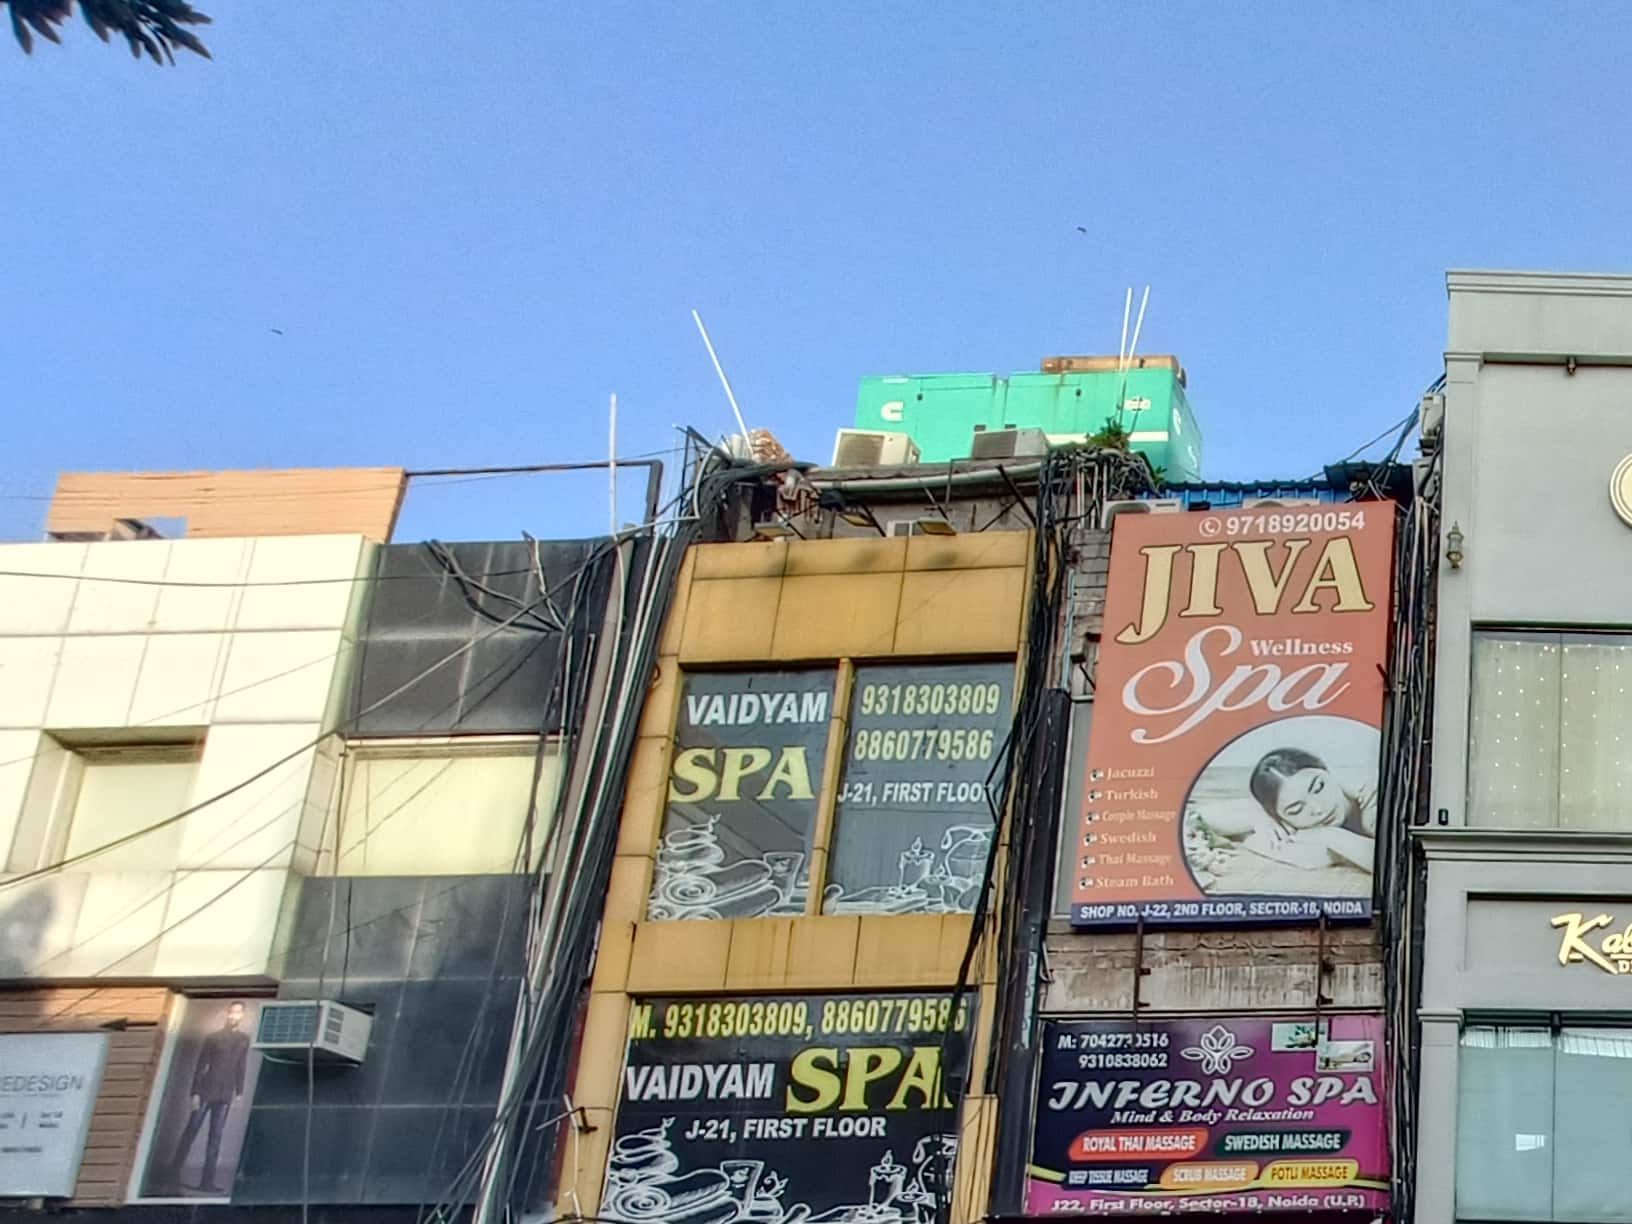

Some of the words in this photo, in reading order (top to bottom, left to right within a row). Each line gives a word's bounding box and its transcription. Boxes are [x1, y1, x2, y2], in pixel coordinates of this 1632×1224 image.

[1225, 511, 1366, 536] 9718920054
[1114, 535, 1376, 645] JIVA
[1249, 638, 1353, 656] Wellness
[1122, 625, 1351, 744] Spa
[687, 691, 827, 726] VAIDYAM
[861, 684, 1000, 716] 9318303809
[853, 729, 994, 760] 8860779586
[669, 746, 817, 803] SPA
[1106, 766, 1155, 781] Jacuzzi
[882, 782, 931, 803] FIRST
[1106, 788, 1159, 801] Turkish
[1100, 832, 1157, 845] Swedish
[1095, 877, 1139, 889] Steam
[1142, 875, 1175, 887] Bath
[1080, 905, 1115, 919] SHOP
[1117, 904, 1139, 918] NO.
[1174, 903, 1200, 916] 2ND
[1202, 902, 1247, 918] FLOOR,
[1249, 902, 1321, 918] SECTOR-18,
[1323, 901, 1363, 915] NOIDA
[630, 1004, 656, 1040] M.
[663, 1001, 814, 1040] 9318303809,
[1058, 1034, 1077, 1049] M:
[1078, 1053, 1168, 1069] 9310838062
[626, 1063, 776, 1101] VAIDYAM
[785, 1046, 954, 1113] SPA
[1048, 1078, 1276, 1111] INFERNO
[1287, 1076, 1379, 1106] SPA
[1110, 1109, 1156, 1124] Mind
[1159, 1110, 1175, 1123] &
[1178, 1109, 1222, 1125] Body
[1225, 1107, 1315, 1122] Relaxation
[685, 1119, 737, 1143] J-21,
[743, 1118, 808, 1139] FIRST
[812, 1117, 887, 1138] FLOOR
[1082, 1136, 1117, 1152] ROYAL
[1118, 1135, 1144, 1151] THAI
[1145, 1134, 1197, 1151] MASSAGE
[1224, 1134, 1281, 1151] SWEDISH
[1283, 1132, 1342, 1150] MASSAGE
[1203, 1167, 1248, 1183] MASSAGE
[1299, 1165, 1349, 1181] MASSAGE
[1089, 1199, 1126, 1211] First
[1130, 1197, 1175, 1212] Floor,
[1178, 1196, 1263, 1212] Sector-18,
[1267, 1195, 1319, 1208] Noida
